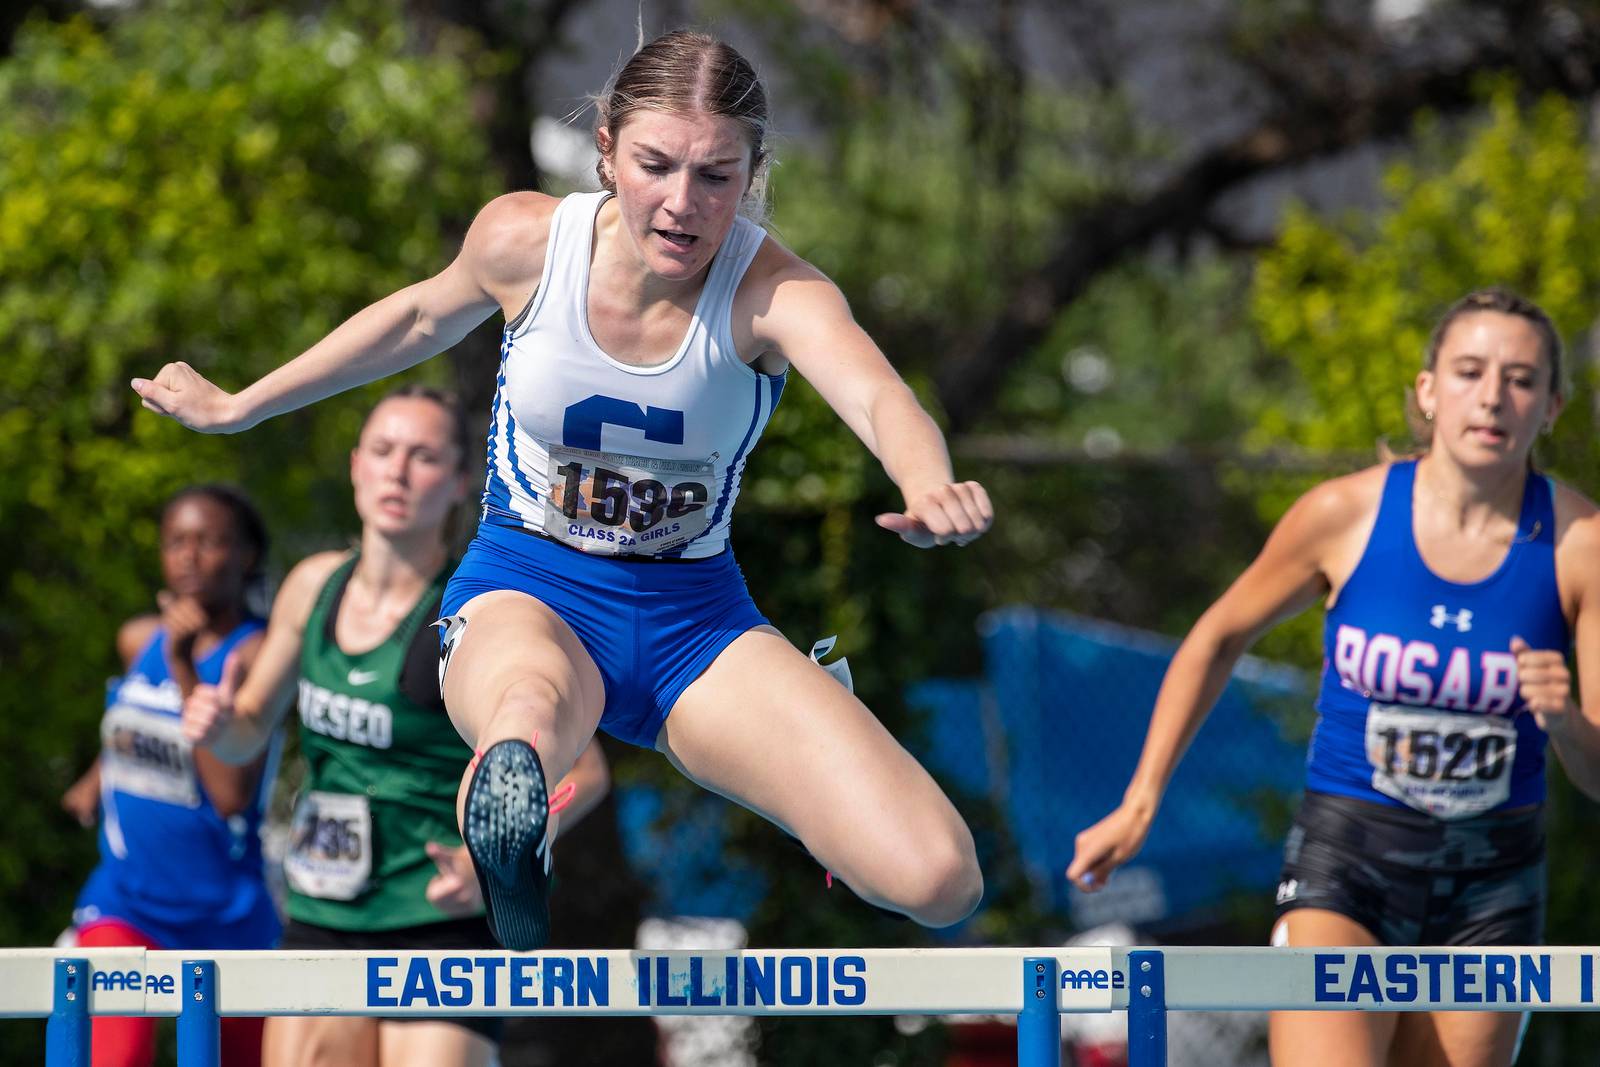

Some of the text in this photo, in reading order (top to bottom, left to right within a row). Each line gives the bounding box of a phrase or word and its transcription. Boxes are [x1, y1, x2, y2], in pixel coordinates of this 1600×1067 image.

[568, 523, 616, 543] CLASS
[619, 535, 637, 546] 2A
[640, 522, 681, 541] GIRLS
[1376, 727, 1507, 781] 1520
[367, 956, 866, 1007] EASTERN ILLINOIS
[1314, 954, 1594, 1003] EASTERN I
